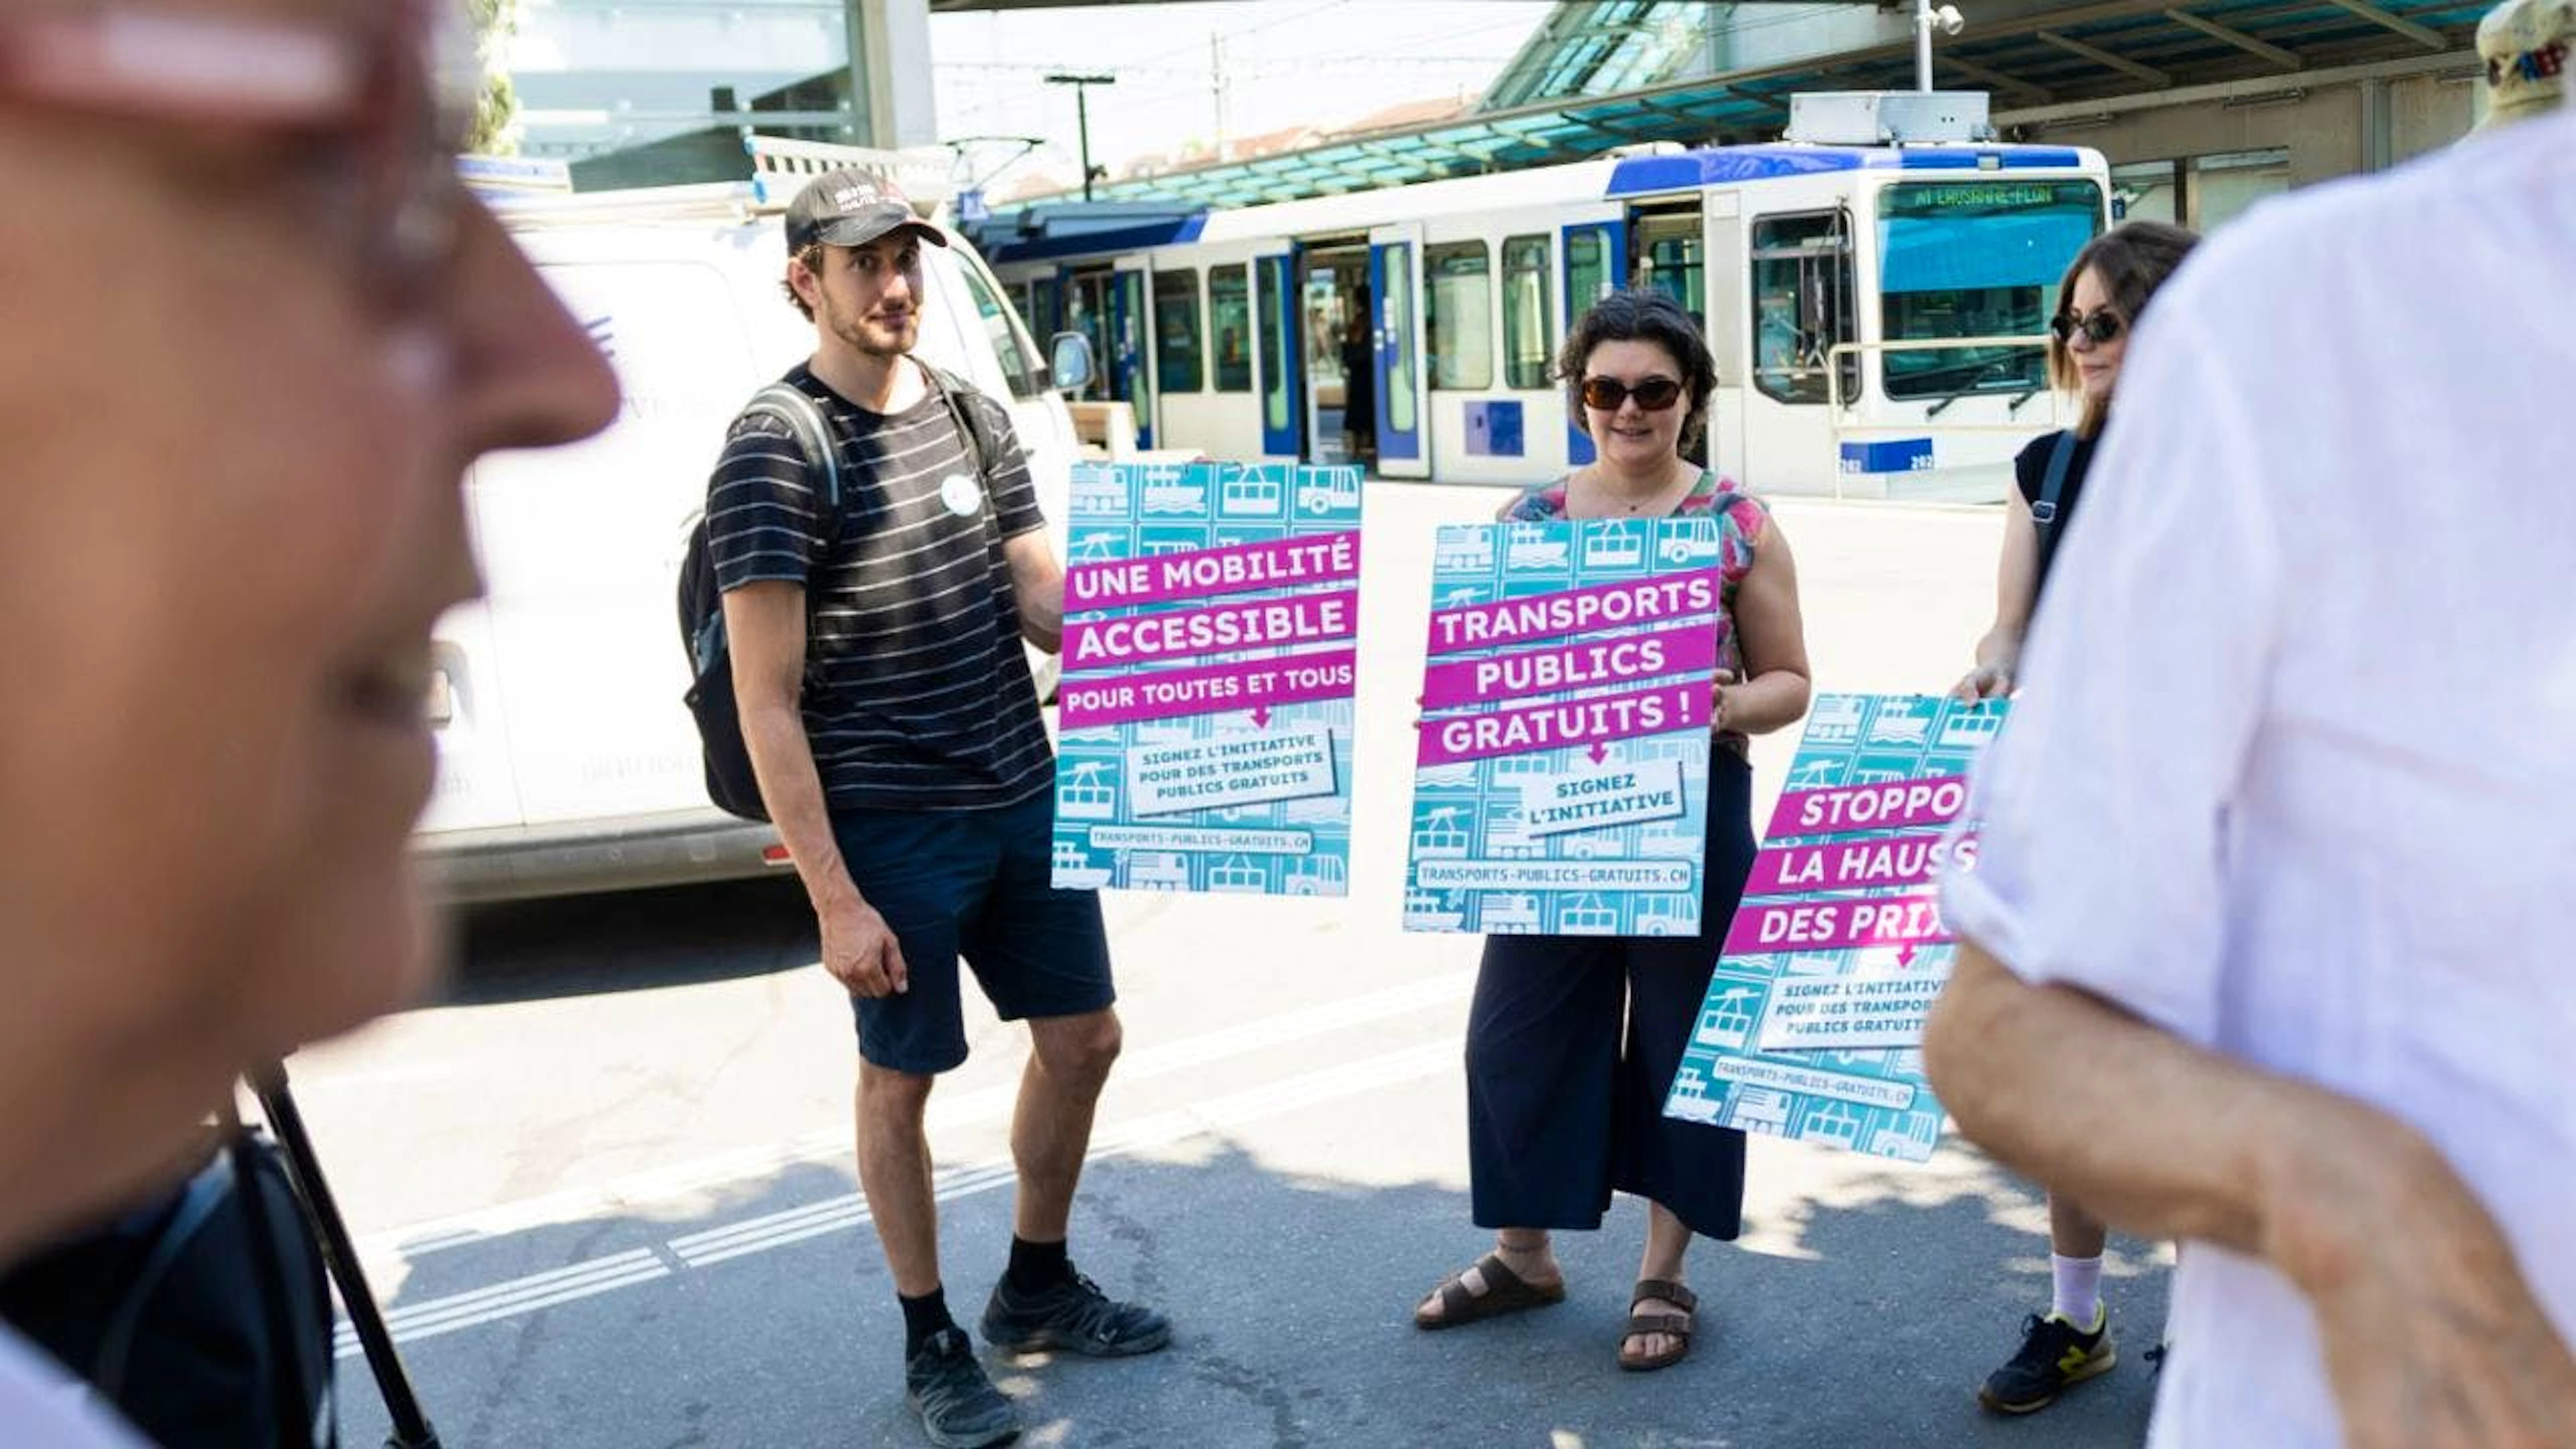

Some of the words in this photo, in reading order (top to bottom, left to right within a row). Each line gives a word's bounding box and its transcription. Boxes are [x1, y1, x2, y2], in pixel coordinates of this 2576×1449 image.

[1074, 567, 1150, 599] UNE
[1163, 535, 1354, 590] MOBILITÉ
[1437, 578, 1713, 644] TRANSPORTS
[1076, 600, 1346, 661] ACCESSIBLE
[1476, 640, 1665, 694] PUBLICS
[1067, 684, 1134, 712] POUR
[1142, 676, 1239, 704] TOUTES
[1248, 672, 1277, 694] ET
[1287, 665, 1353, 690] TOUS
[1442, 696, 1665, 753] GRATUITS
[1679, 691, 1692, 722] !
[1142, 747, 1202, 765] SIGNEZ
[1208, 733, 1316, 759] L'INITIATIVE
[1139, 765, 1181, 784] POUR
[1187, 762, 1217, 777] DES
[1223, 751, 1324, 774] TRANSPORTS
[1157, 781, 1224, 799] PUBLICS
[1229, 771, 1309, 792] GRATUITS
[1556, 773, 1637, 798] SIGNEZ
[1529, 791, 1675, 824] L'INITIATIVE
[1800, 782, 1964, 826] STOPPO
[1093, 831, 1309, 848] TRANSPORTS-PUBLICS-GRATUITS.CH
[1421, 865, 1689, 883] TRANSPORTS-PUBLICS-GRATUITS.CH
[1778, 850, 1825, 884] LA
[1837, 840, 1978, 881] HAUSS
[1759, 907, 1838, 943] DES
[1847, 903, 1952, 940] PRIX
[1784, 983, 1838, 997] SIGNEZ
[1820, 1001, 1847, 1014] DES
[1786, 1020, 1848, 1033] PUBLICS
[1854, 1018, 1925, 1031] GRATUIT
[1718, 1061, 1910, 1102] TRANSPORTS-PUBLICS-GRATUITS.CH
